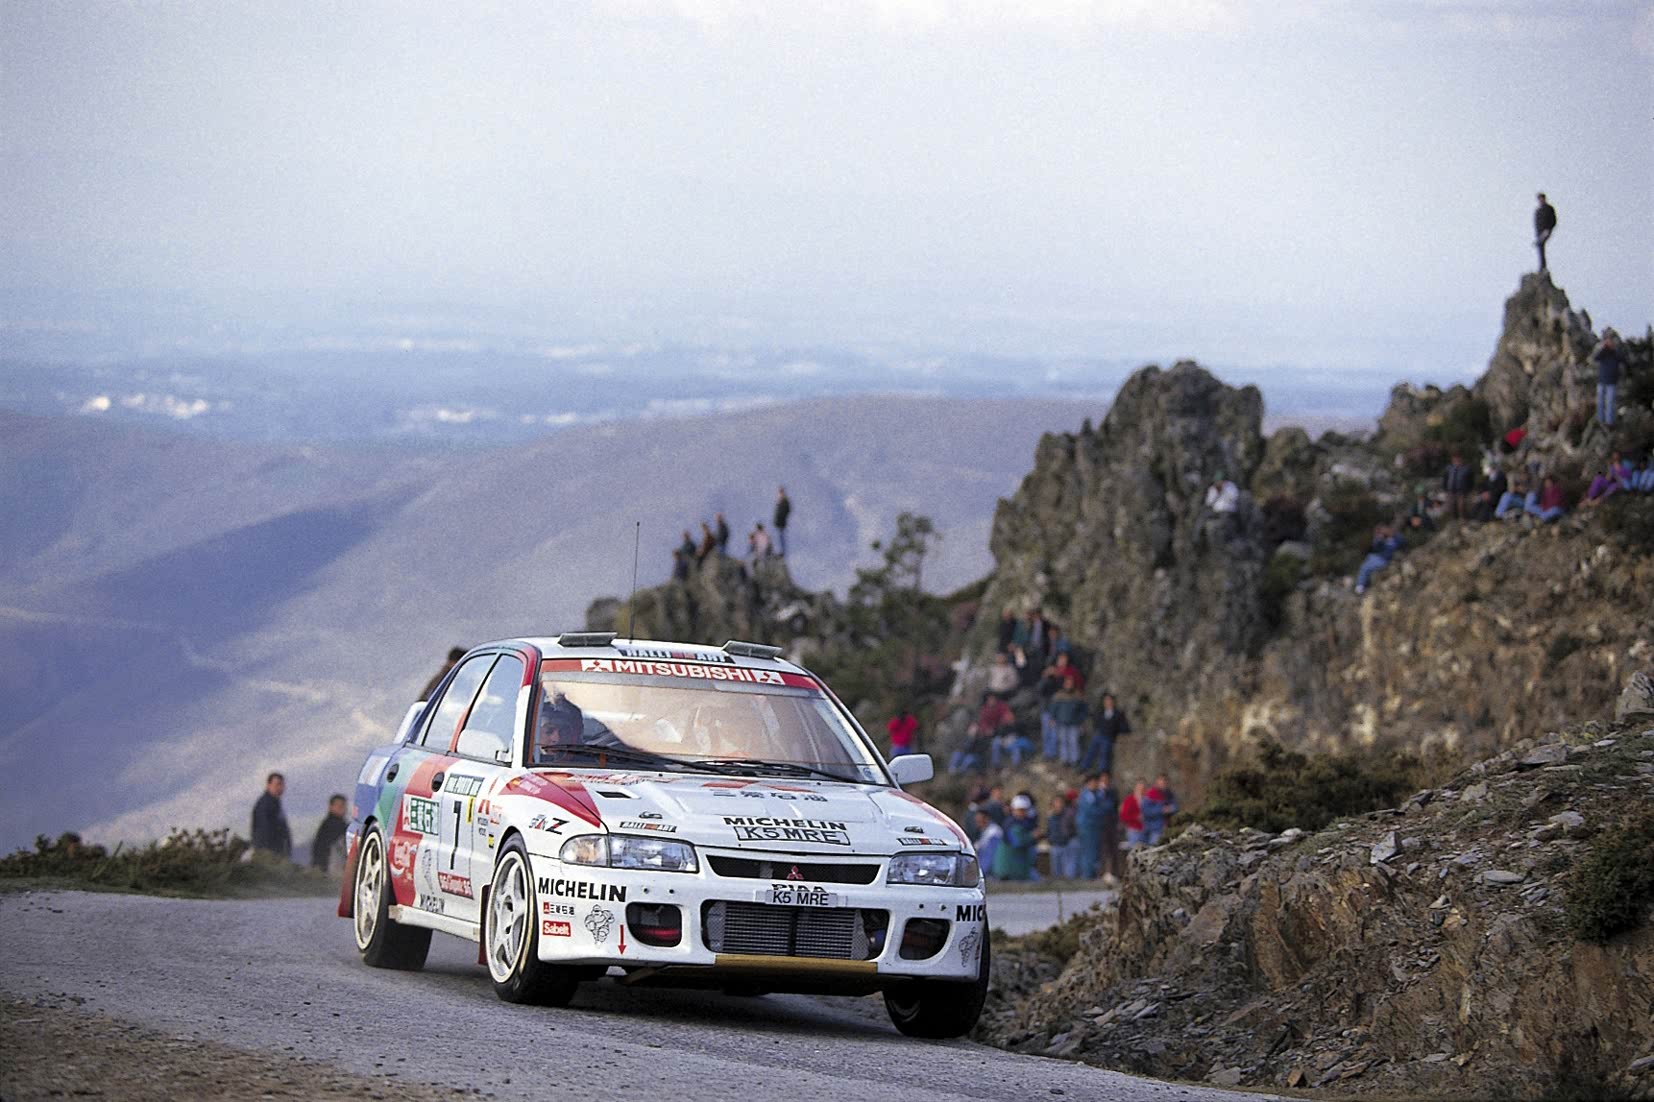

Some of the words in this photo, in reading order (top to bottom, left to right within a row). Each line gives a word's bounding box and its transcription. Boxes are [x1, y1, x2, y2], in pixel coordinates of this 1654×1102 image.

[615, 660, 752, 682] MITSUBISHI
[723, 817, 847, 831] MICHELIN
[450, 800, 462, 870] 1
[745, 827, 780, 839] K5
[783, 829, 838, 843] MRE
[538, 877, 627, 902] MICHELIN
[772, 891, 792, 904] K5
[796, 893, 830, 906] MRE
[544, 921, 570, 936] Sabelt
